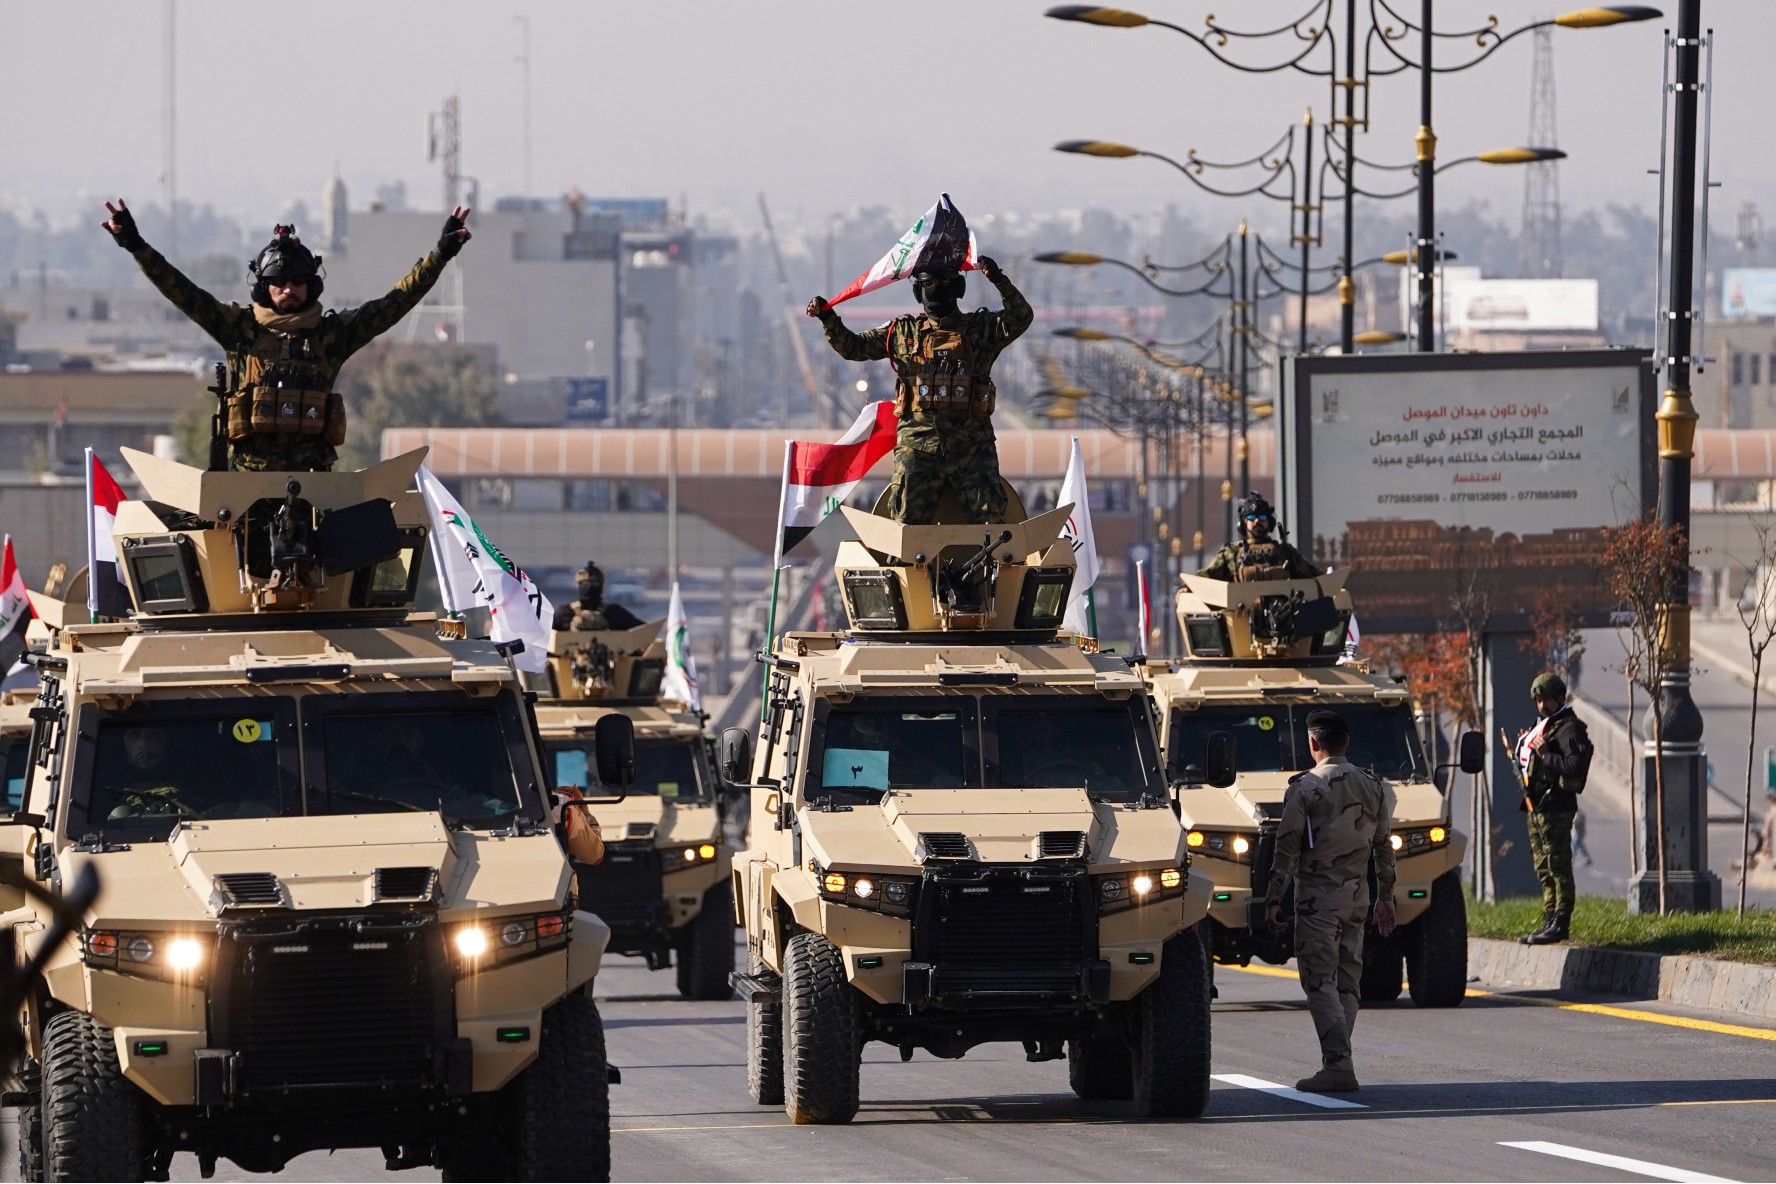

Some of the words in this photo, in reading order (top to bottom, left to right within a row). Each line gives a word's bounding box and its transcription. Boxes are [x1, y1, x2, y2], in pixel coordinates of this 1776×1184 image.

[1402, 406, 1447, 421] الموصل
[1450, 405, 1486, 420] ميدان
[1490, 404, 1517, 419] تاون
[1520, 403, 1549, 418] داون
[1369, 429, 1418, 446] الموصل
[1423, 429, 1446, 447] في
[1487, 426, 1533, 446] التجاري
[1538, 425, 1583, 444] المجمع
[1406, 453, 1444, 468] ومواقع
[1491, 451, 1543, 463] بمساحات
[1546, 449, 1581, 461] محلات
[1452, 471, 1502, 486] للاستفسار
[237, 724, 255, 737] ١٣
